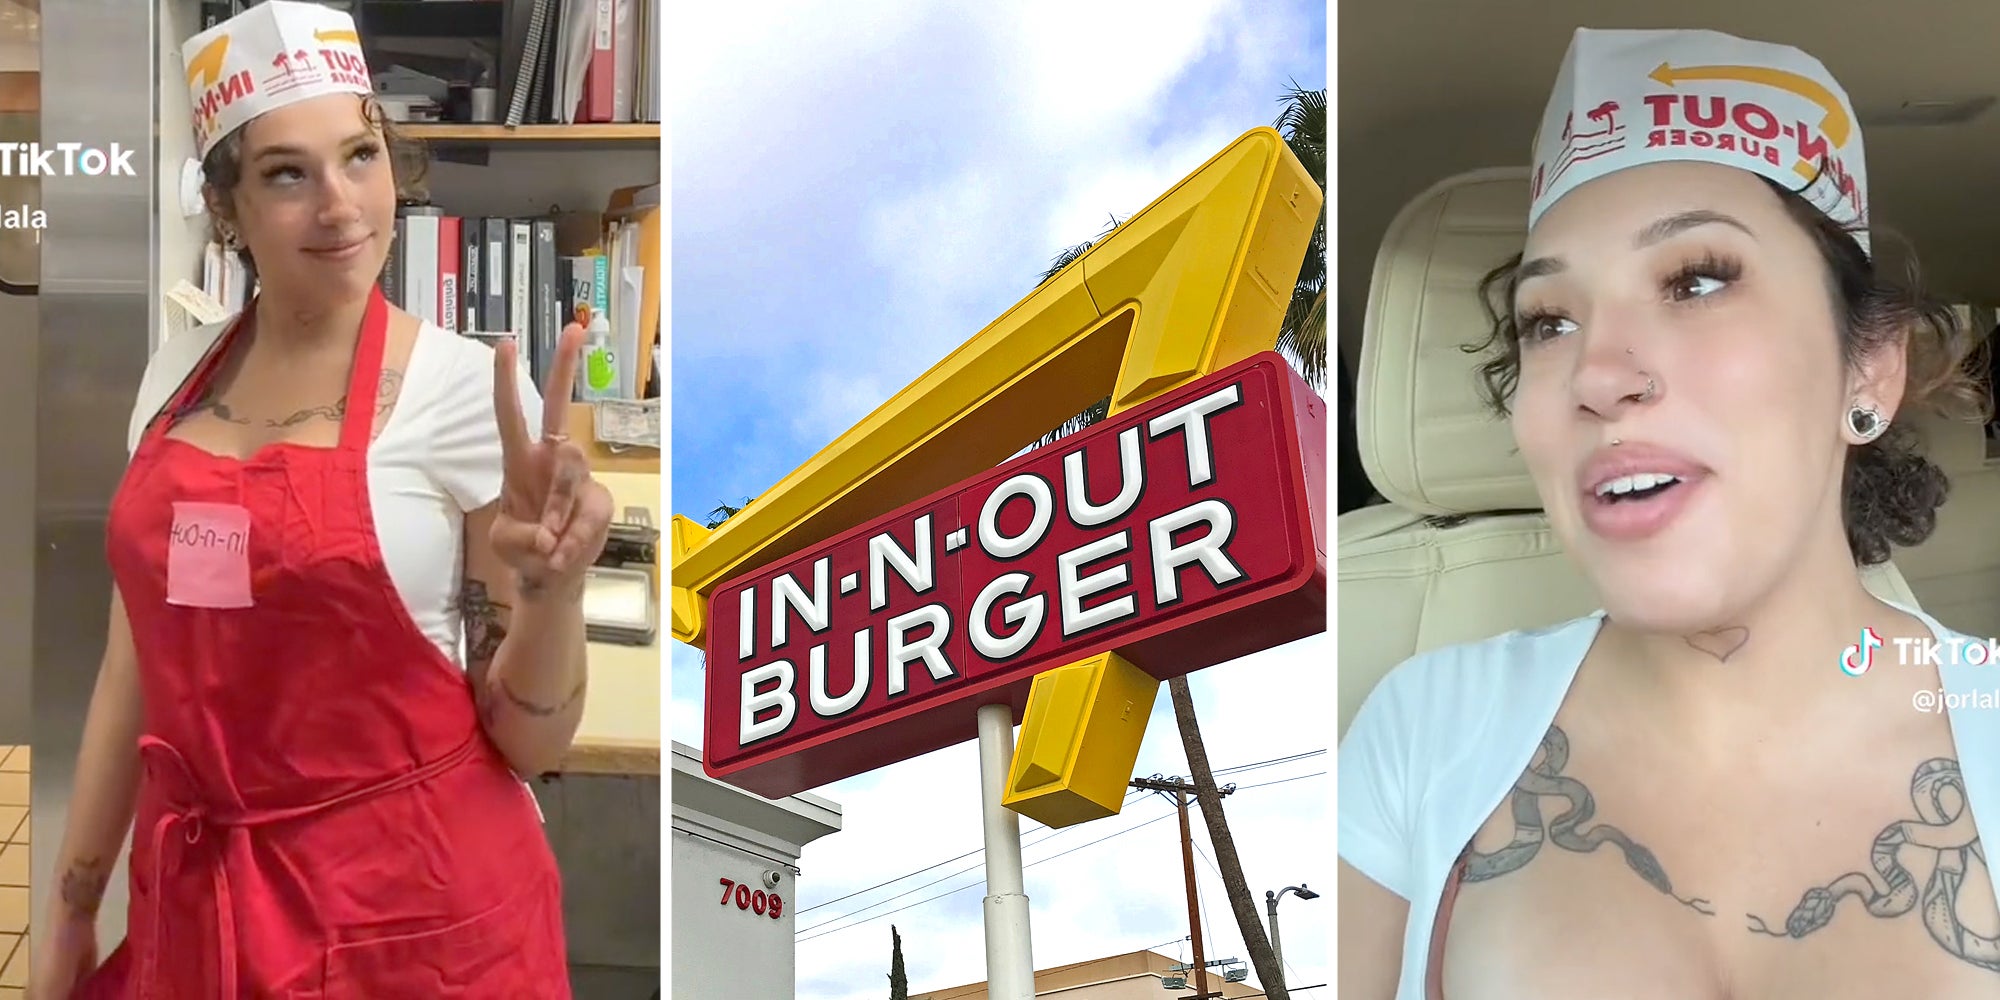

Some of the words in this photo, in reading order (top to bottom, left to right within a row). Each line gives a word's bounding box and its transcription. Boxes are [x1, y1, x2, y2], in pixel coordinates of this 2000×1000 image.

[738, 383, 1244, 662] IN-N-OUT
[738, 496, 1246, 748] BURGER
[719, 877, 783, 920] 7009
